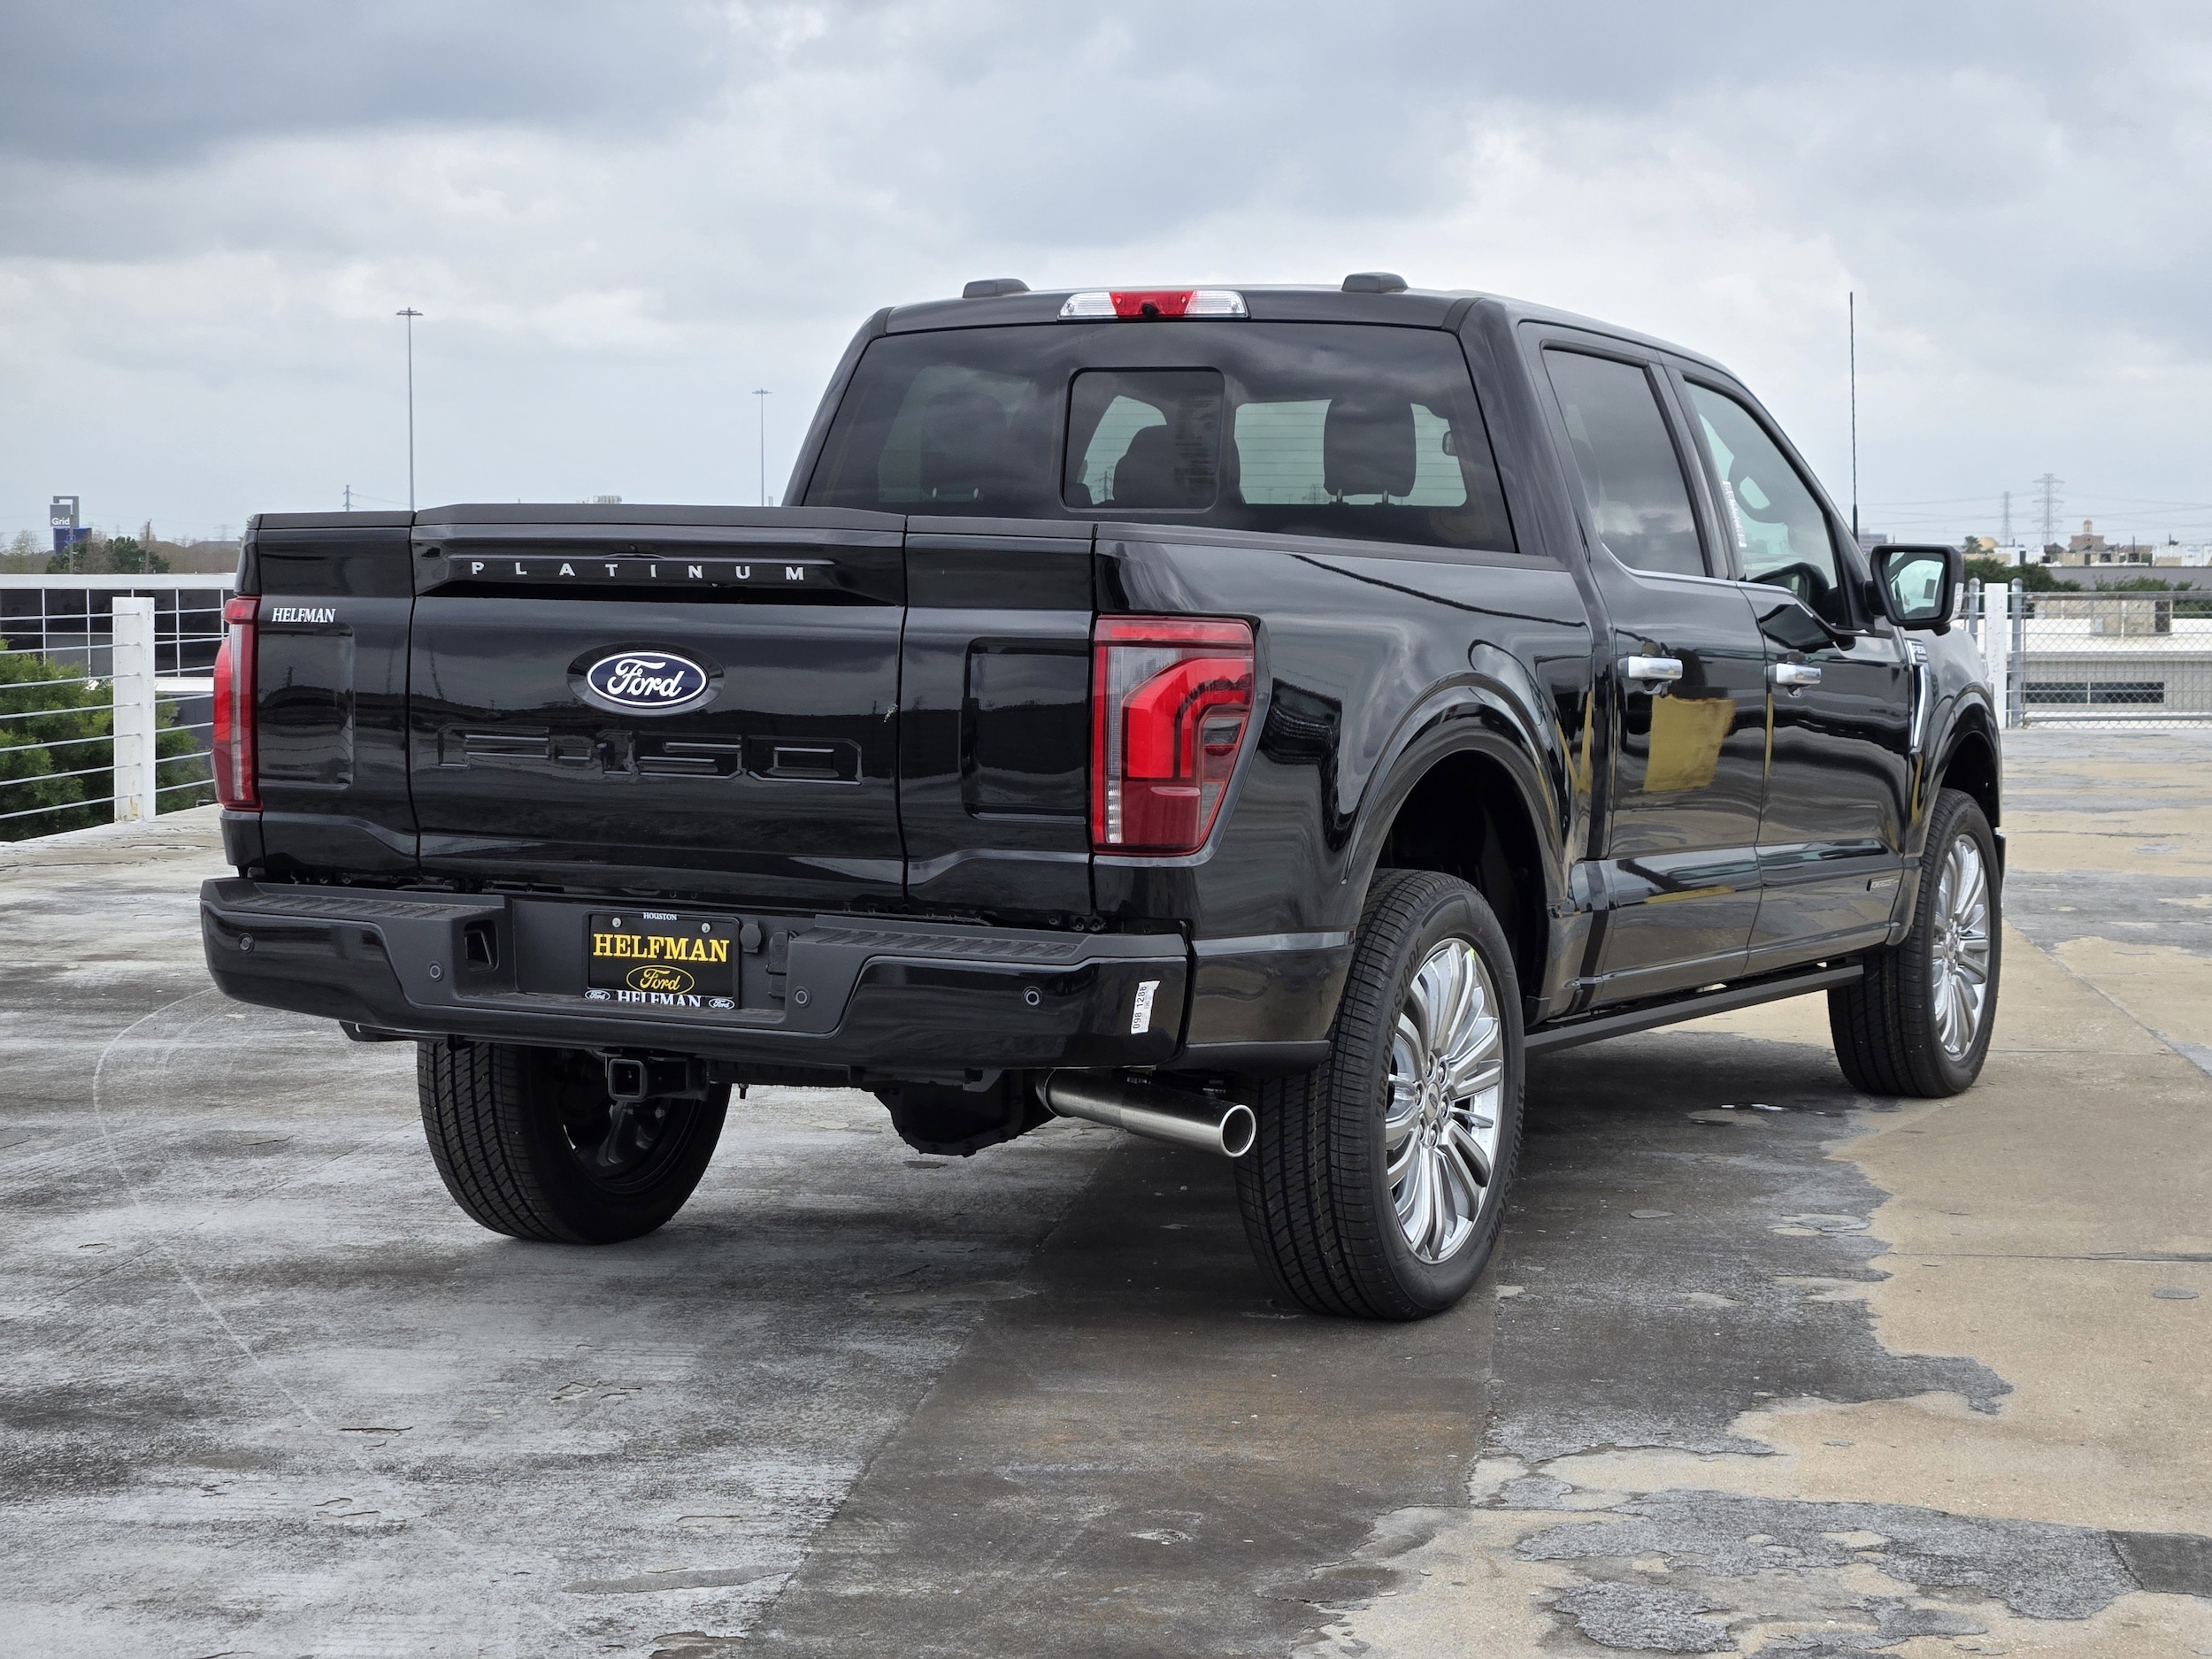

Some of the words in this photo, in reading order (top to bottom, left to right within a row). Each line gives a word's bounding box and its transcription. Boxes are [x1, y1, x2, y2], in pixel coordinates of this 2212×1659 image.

[471, 562, 805, 581] PLATINUM
[271, 607, 336, 623] HELFMAN
[606, 657, 685, 697] Ford
[642, 911, 678, 921] HOUSTON
[592, 933, 731, 963] HELFMAN
[639, 968, 681, 991] Ford
[1136, 986, 1148, 1008] 1288
[1132, 1011, 1142, 1029] 098
